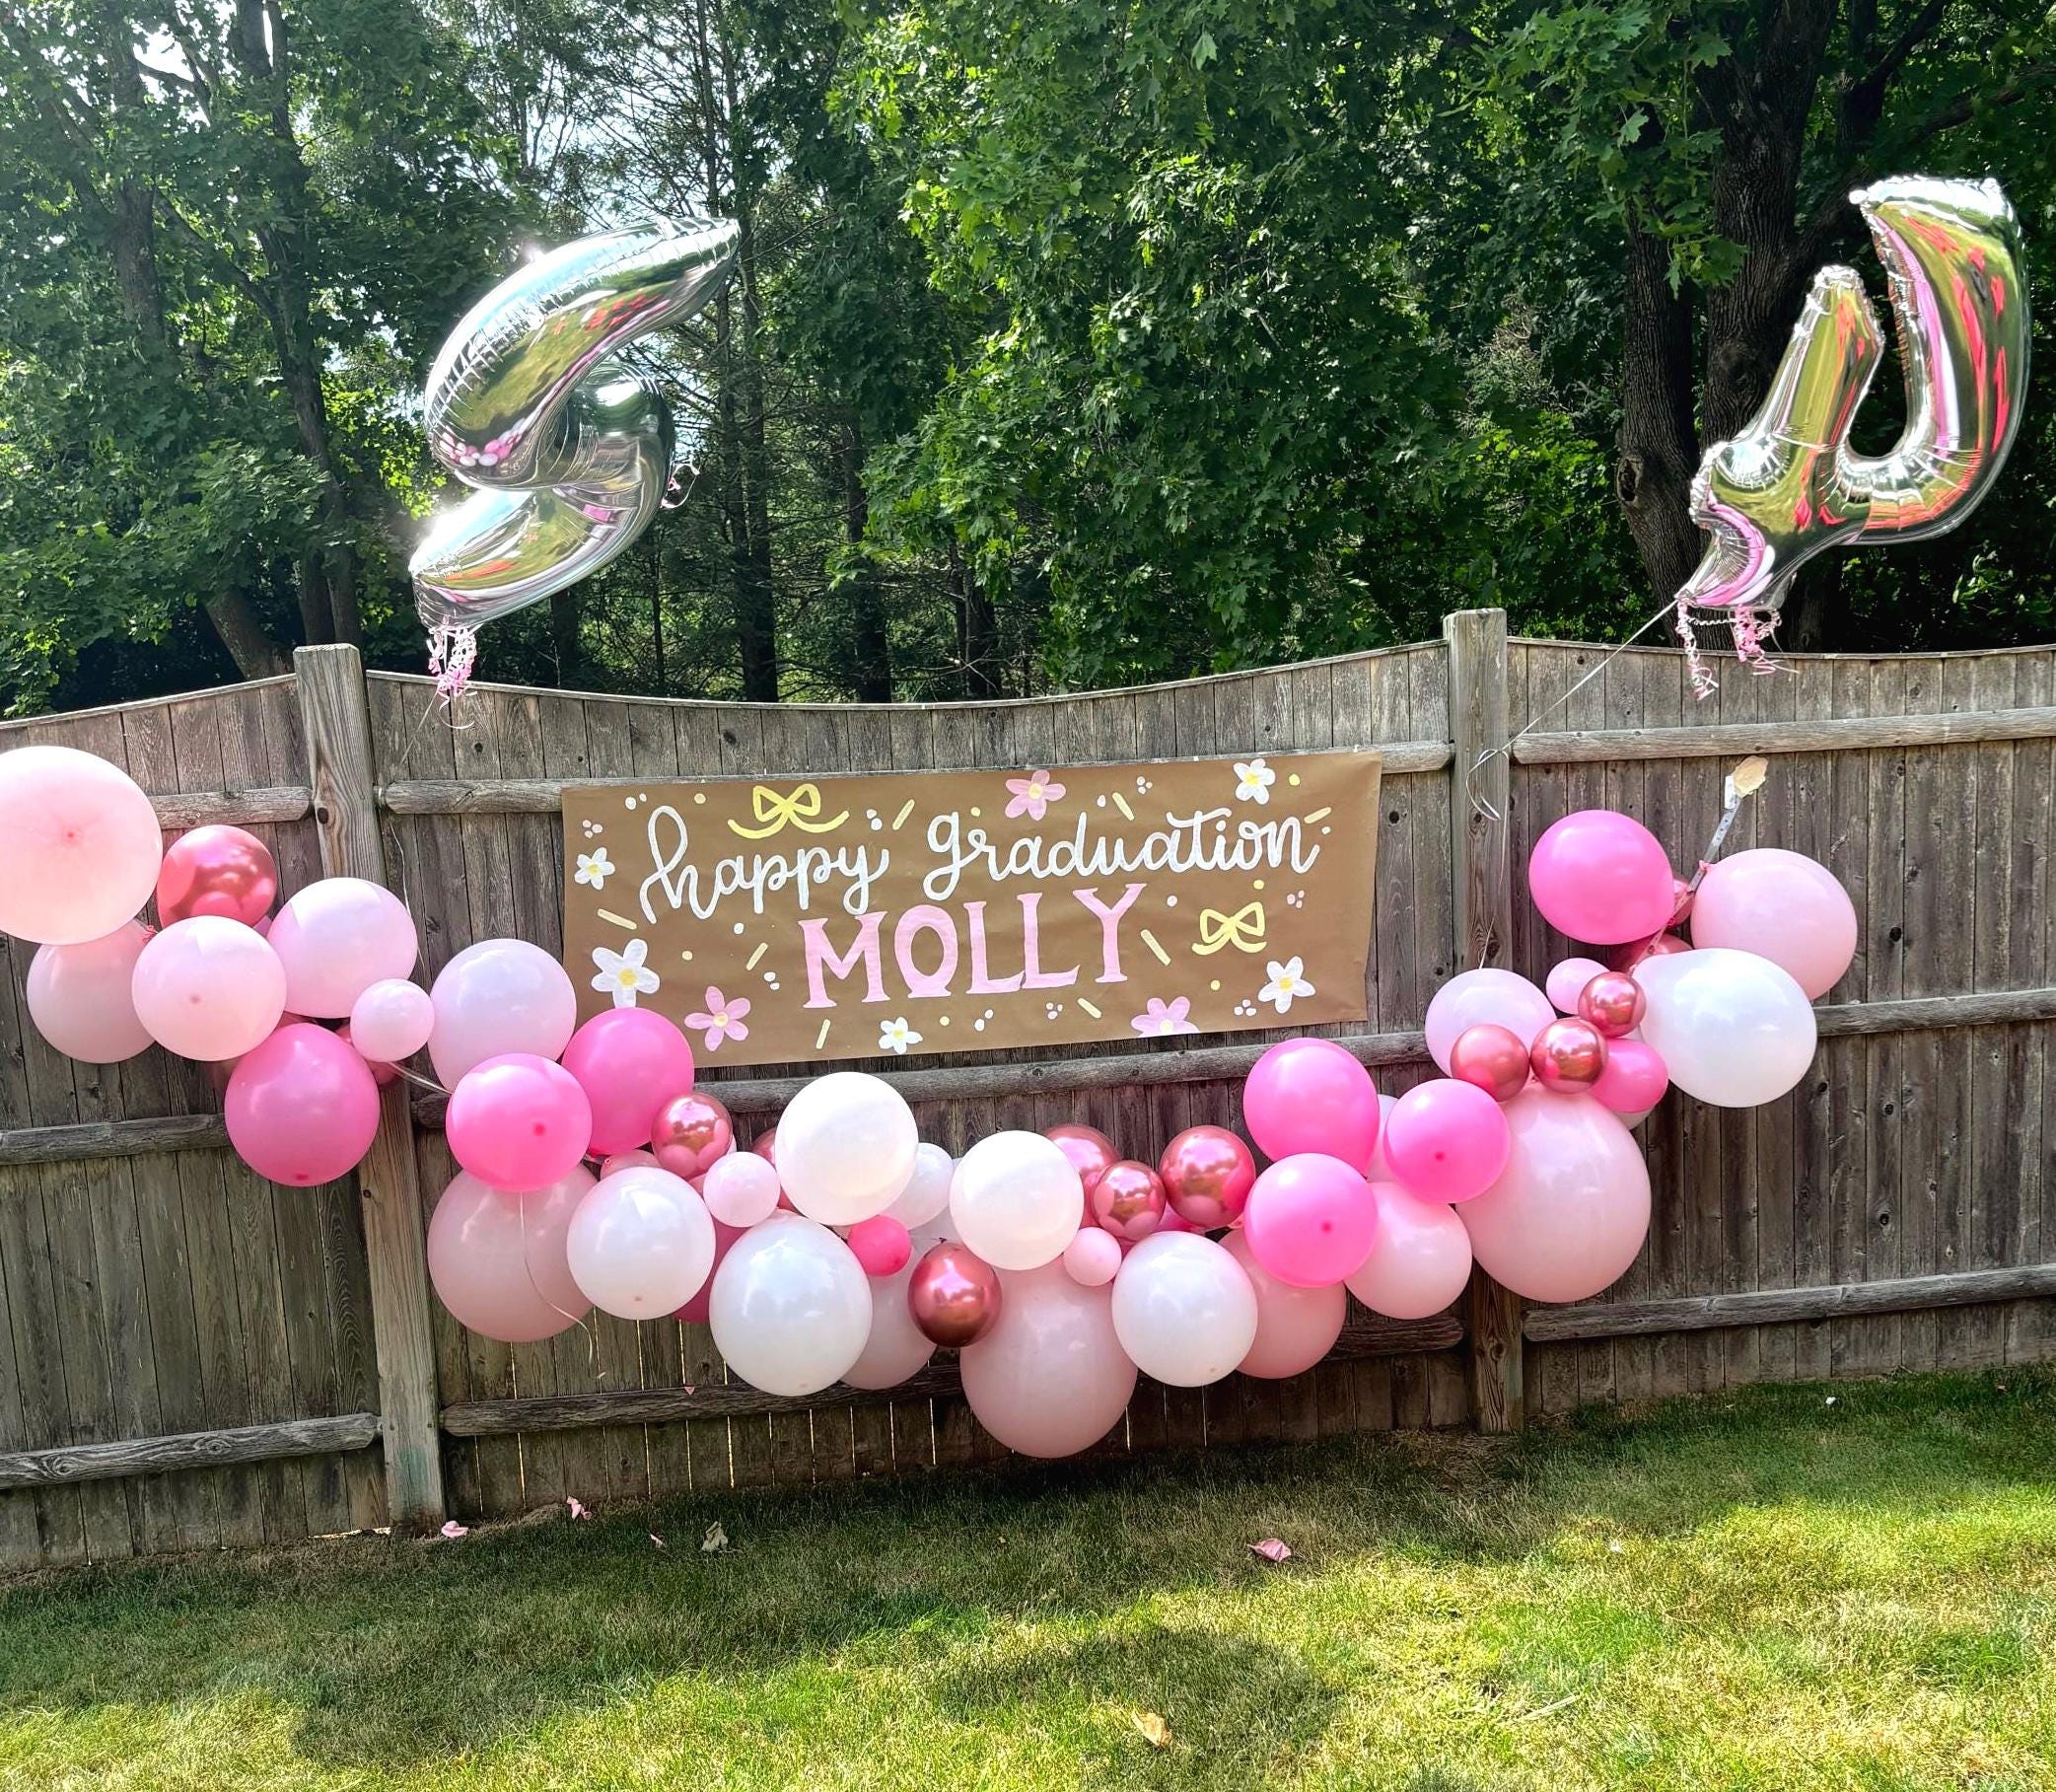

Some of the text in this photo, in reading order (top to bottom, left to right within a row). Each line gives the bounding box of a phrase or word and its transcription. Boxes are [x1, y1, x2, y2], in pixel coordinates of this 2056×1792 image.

[639, 805, 1320, 924] happy graduation
[797, 883, 1148, 1008] MOLLY
